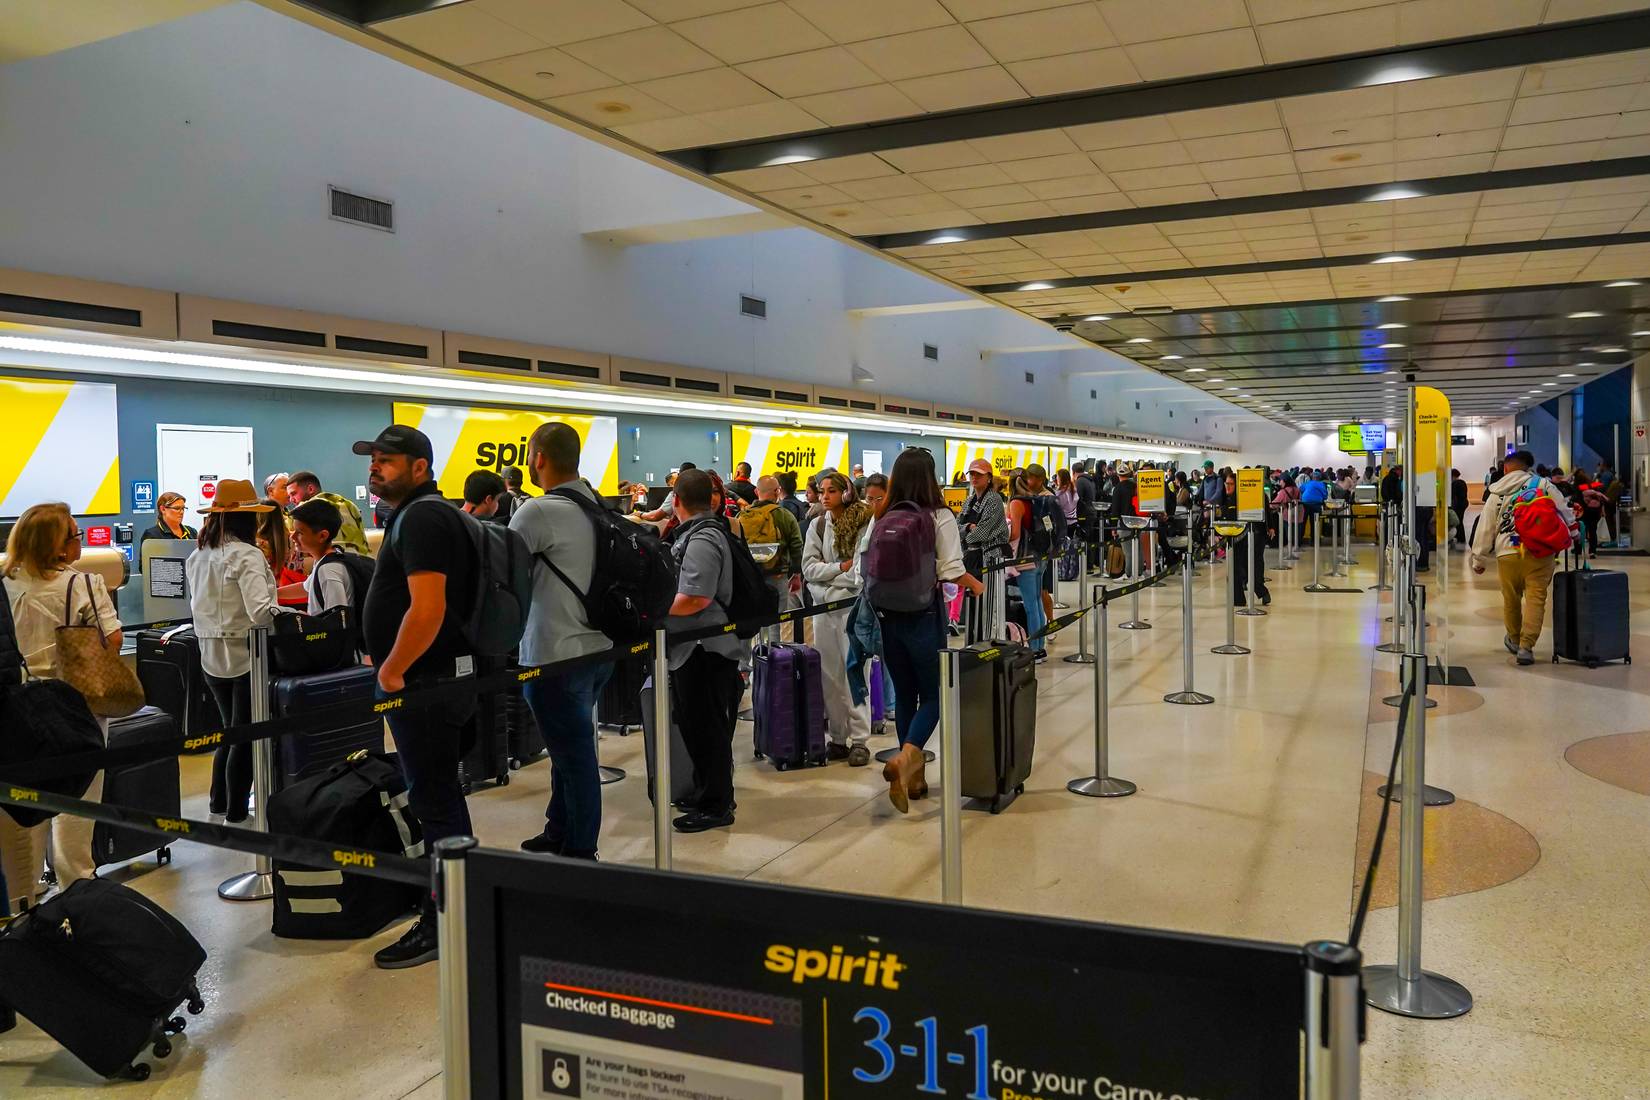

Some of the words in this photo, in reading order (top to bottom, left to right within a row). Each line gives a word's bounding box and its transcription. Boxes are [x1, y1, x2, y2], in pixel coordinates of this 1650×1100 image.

[475, 436, 530, 474] spi
[776, 447, 816, 473] spirit
[995, 455, 1013, 471] spirit
[1140, 476, 1162, 484] Agent
[305, 631, 328, 641] spirit
[723, 623, 737, 632] spirit
[630, 641, 650, 654] spirit
[517, 667, 542, 681] spirit
[374, 698, 403, 713] spirit
[183, 732, 224, 749] spirit
[10, 787, 40, 802] spirit
[156, 817, 191, 833] spirit
[333, 849, 376, 868] spirit
[764, 944, 903, 990] spirit
[545, 992, 607, 1017] Checked
[610, 1002, 675, 1029] Baggage
[852, 1006, 997, 1100] 3-1-1
[585, 1056, 601, 1067] Are
[604, 1061, 625, 1072] your
[627, 1064, 648, 1077] bags
[650, 1068, 686, 1083] locked?
[992, 1059, 1026, 1086] for
[1031, 1069, 1088, 1097] your
[585, 1069, 597, 1080] Be
[600, 1073, 619, 1084] sure
[622, 1077, 632, 1087] to
[633, 1080, 648, 1090] use
[586, 1082, 601, 1094] For
[604, 1087, 627, 1099] more
